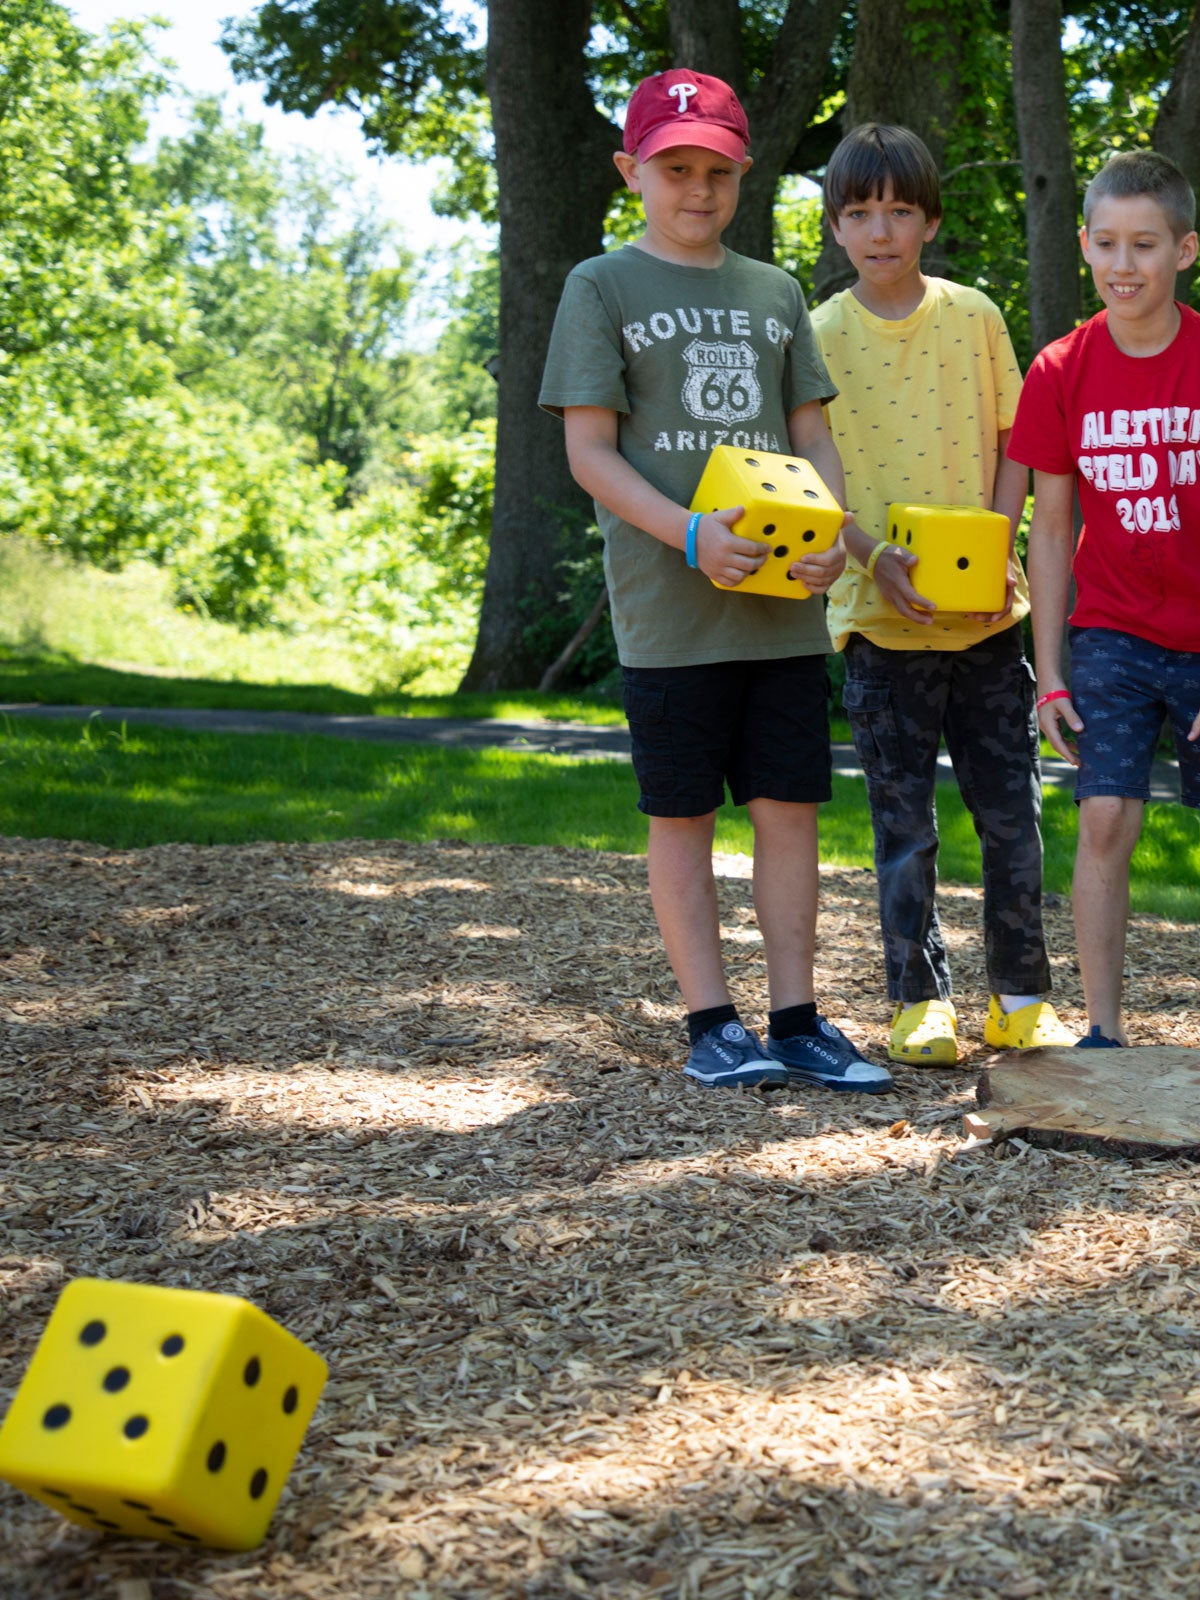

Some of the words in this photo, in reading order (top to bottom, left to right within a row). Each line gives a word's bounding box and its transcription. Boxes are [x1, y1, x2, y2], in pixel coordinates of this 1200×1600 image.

[668, 83, 698, 113] P
[622, 307, 751, 353] ROUTE
[697, 349, 748, 365] ROUTE
[700, 372, 749, 411] 66
[654, 430, 781, 452] ARIZONA
[1078, 452, 1158, 492] FIELD
